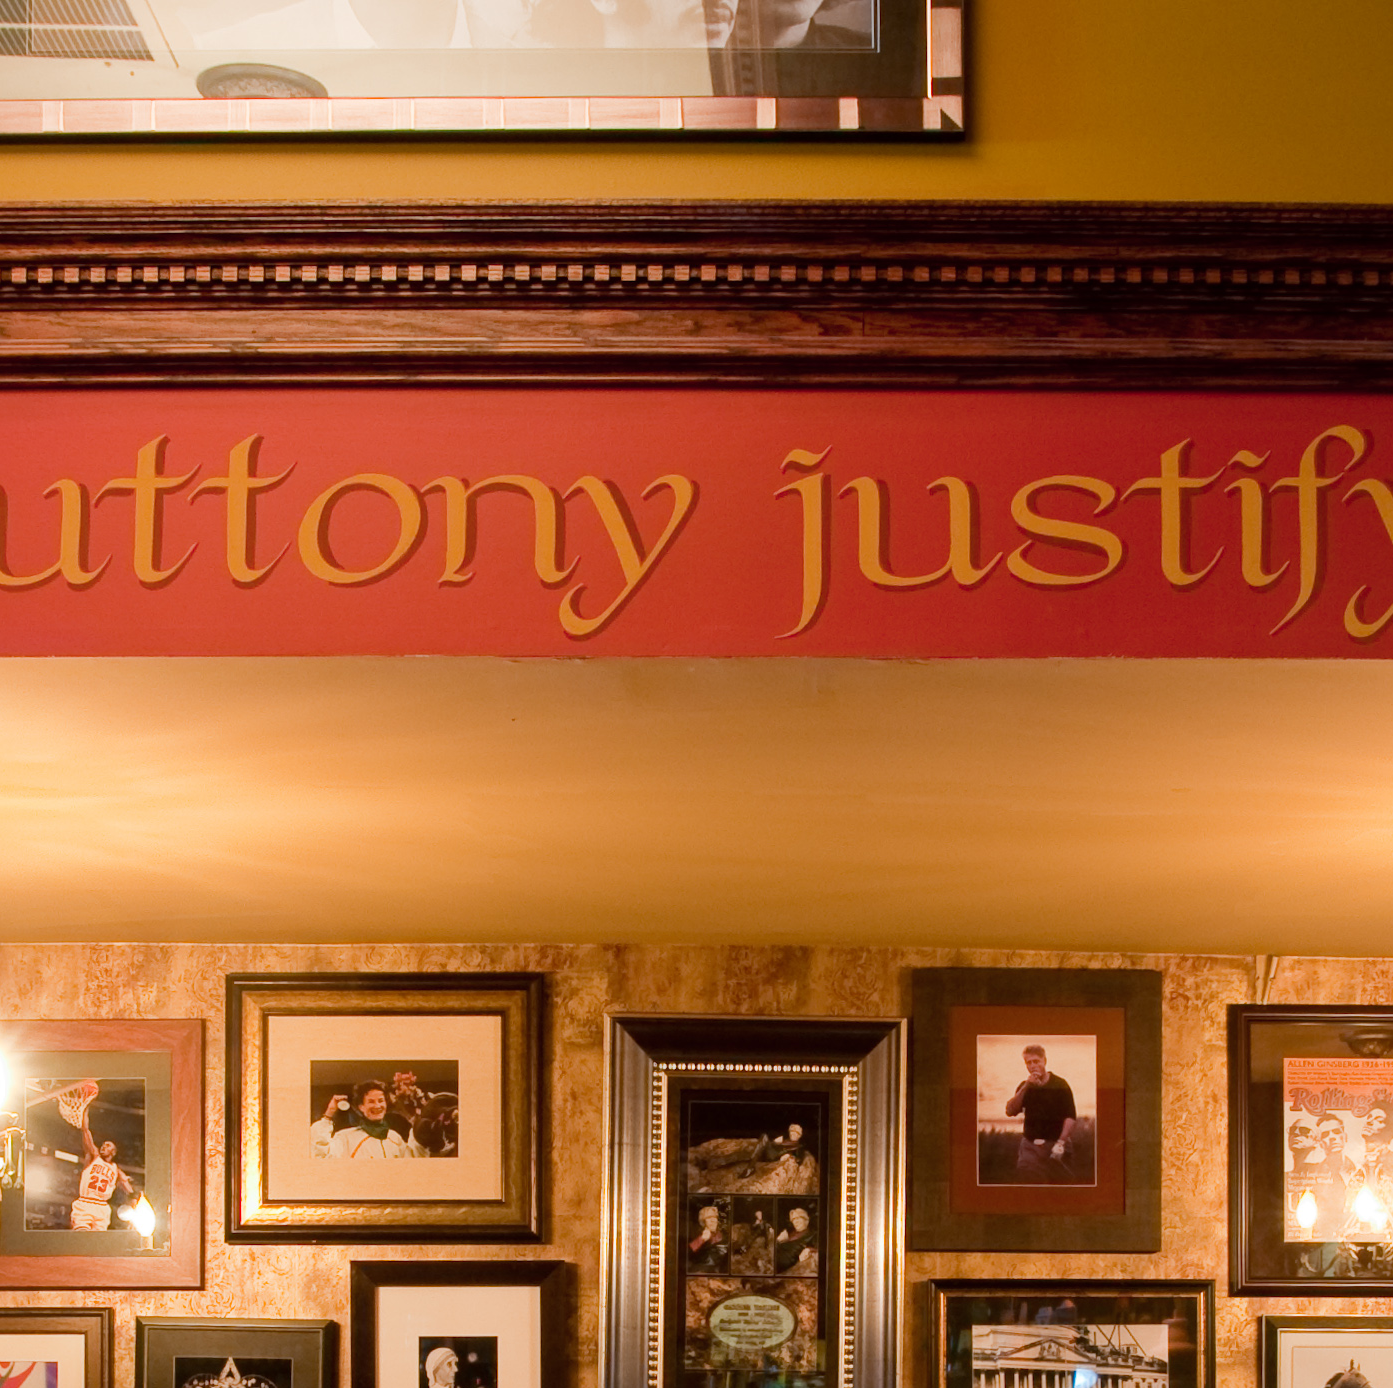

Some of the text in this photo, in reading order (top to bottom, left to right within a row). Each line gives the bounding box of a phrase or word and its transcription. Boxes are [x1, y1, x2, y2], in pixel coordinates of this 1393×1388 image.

[1287, 1060, 1314, 1068] ALLEN
[1316, 1060, 1360, 1068] GINSBERG
[1288, 1087, 1372, 1118] Rolling
[87, 1174, 109, 1193] 23
